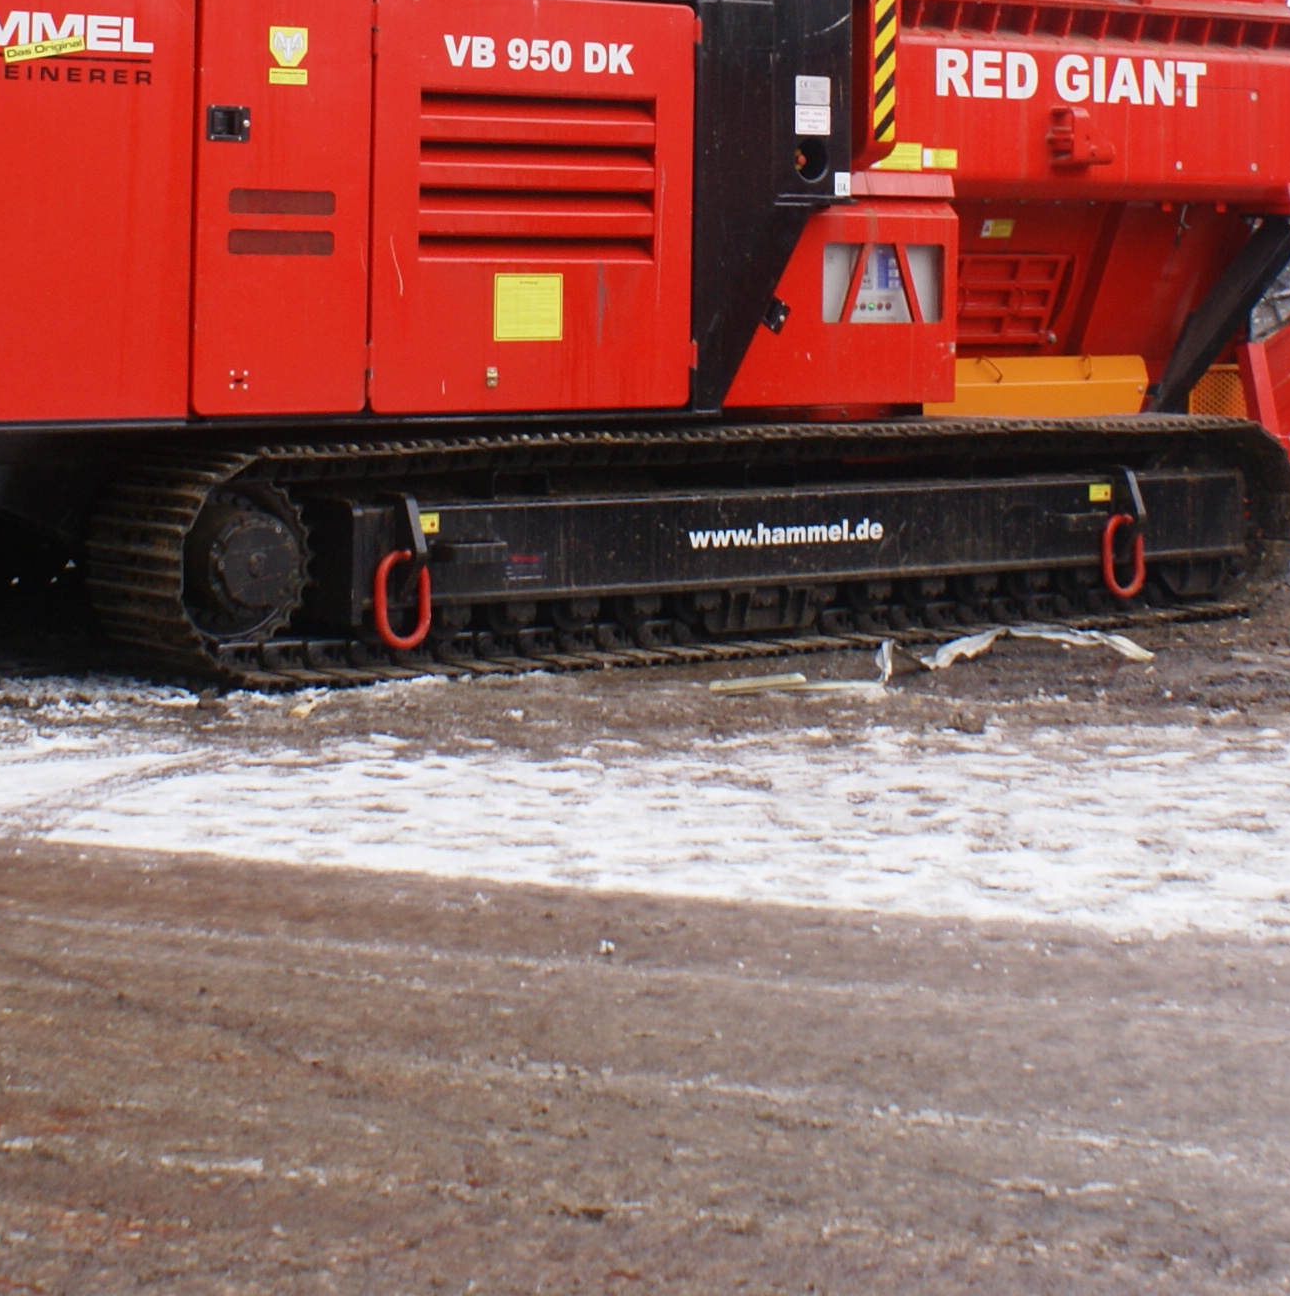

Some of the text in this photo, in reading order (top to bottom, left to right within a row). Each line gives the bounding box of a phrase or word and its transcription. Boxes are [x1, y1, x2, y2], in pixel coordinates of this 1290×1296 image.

[6, 39, 83, 58] Das Original
[443, 34, 635, 76] VB 950 DK
[935, 47, 1208, 108] RED GIANT
[688, 517, 884, 549] www.hammel.de
